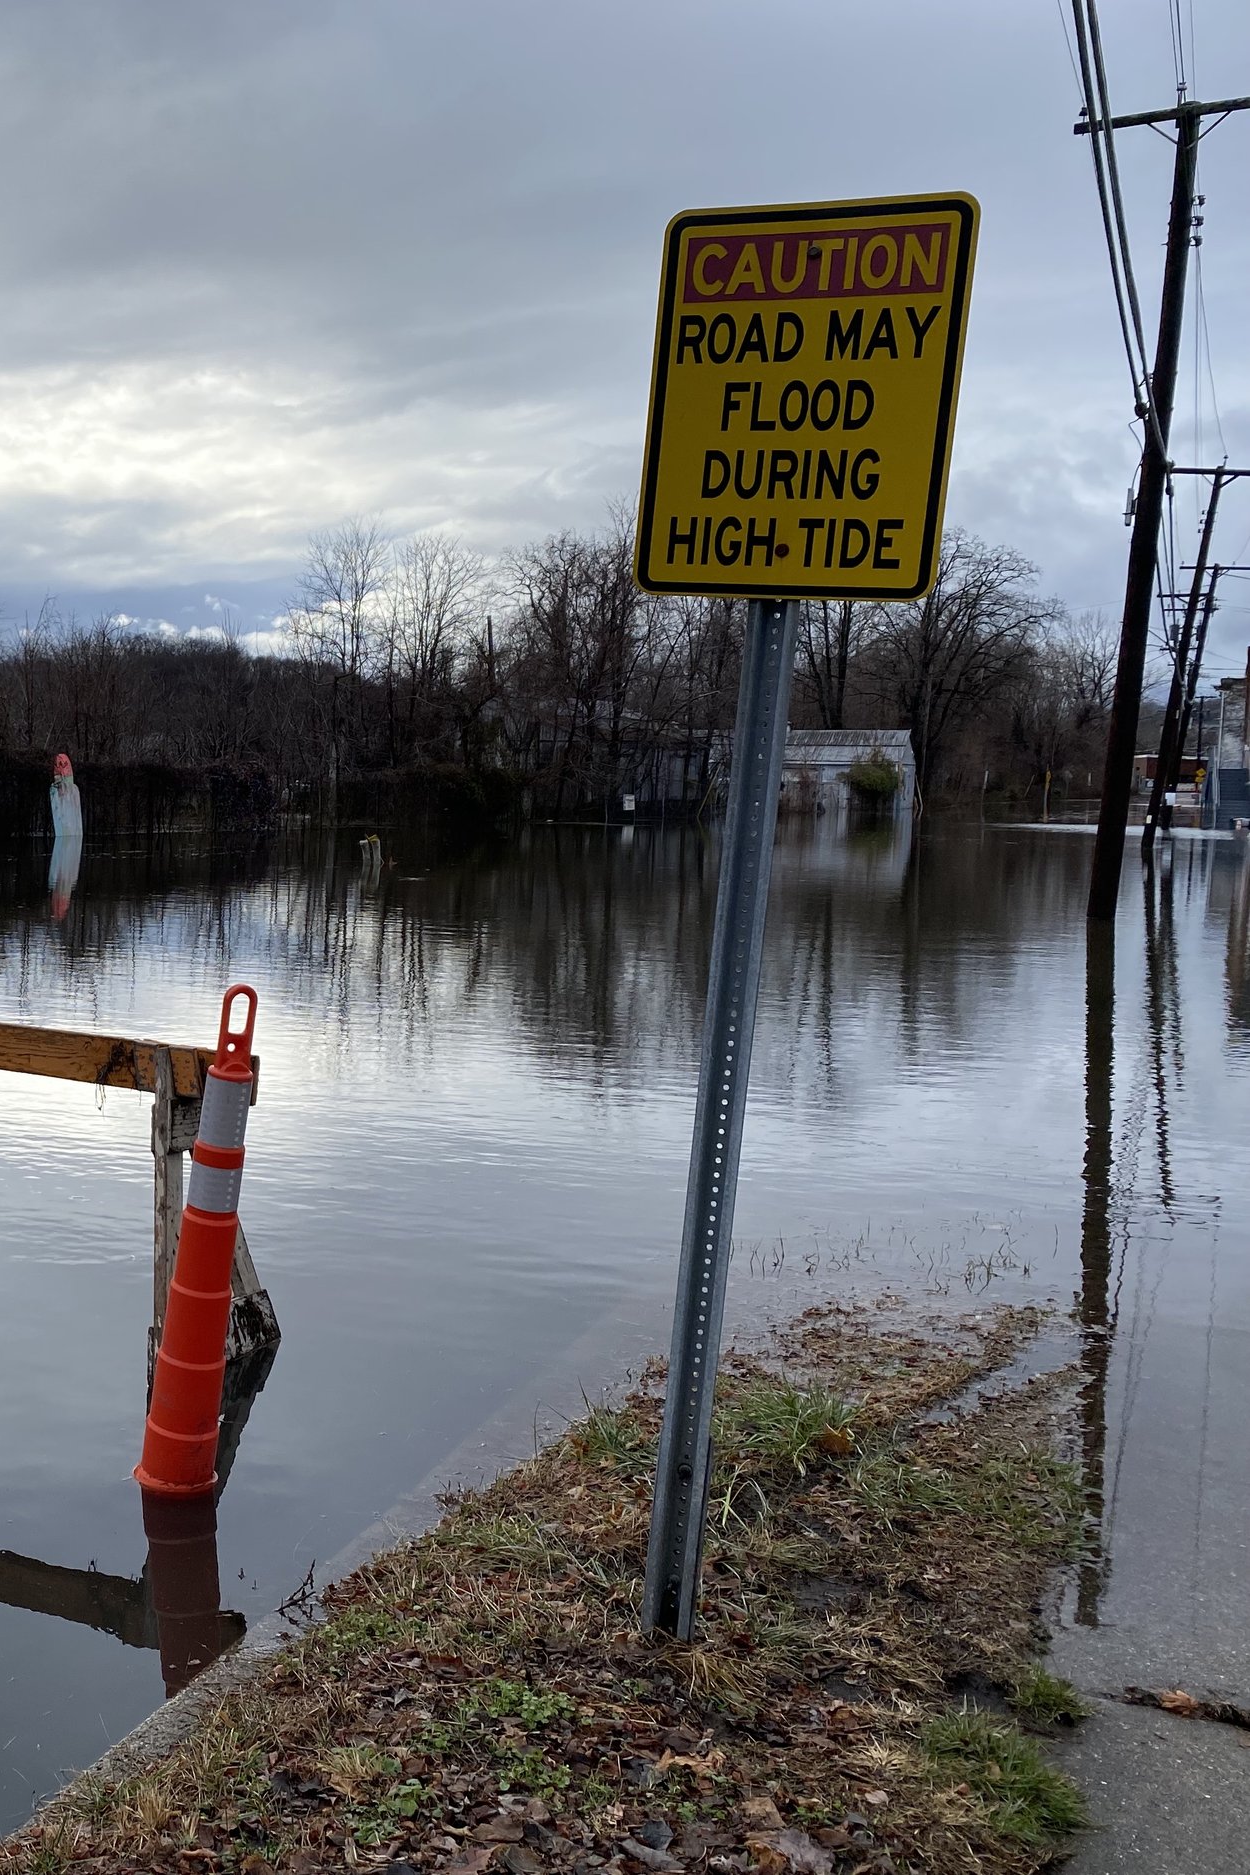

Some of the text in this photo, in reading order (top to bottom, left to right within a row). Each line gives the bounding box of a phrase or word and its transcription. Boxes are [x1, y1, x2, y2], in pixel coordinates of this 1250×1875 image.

[692, 231, 943, 296] CAUTION
[676, 305, 942, 365] ROAD MAY
[721, 379, 875, 432] FLOOD
[701, 448, 881, 501] DURING
[666, 516, 904, 570] HIGH TIDE
